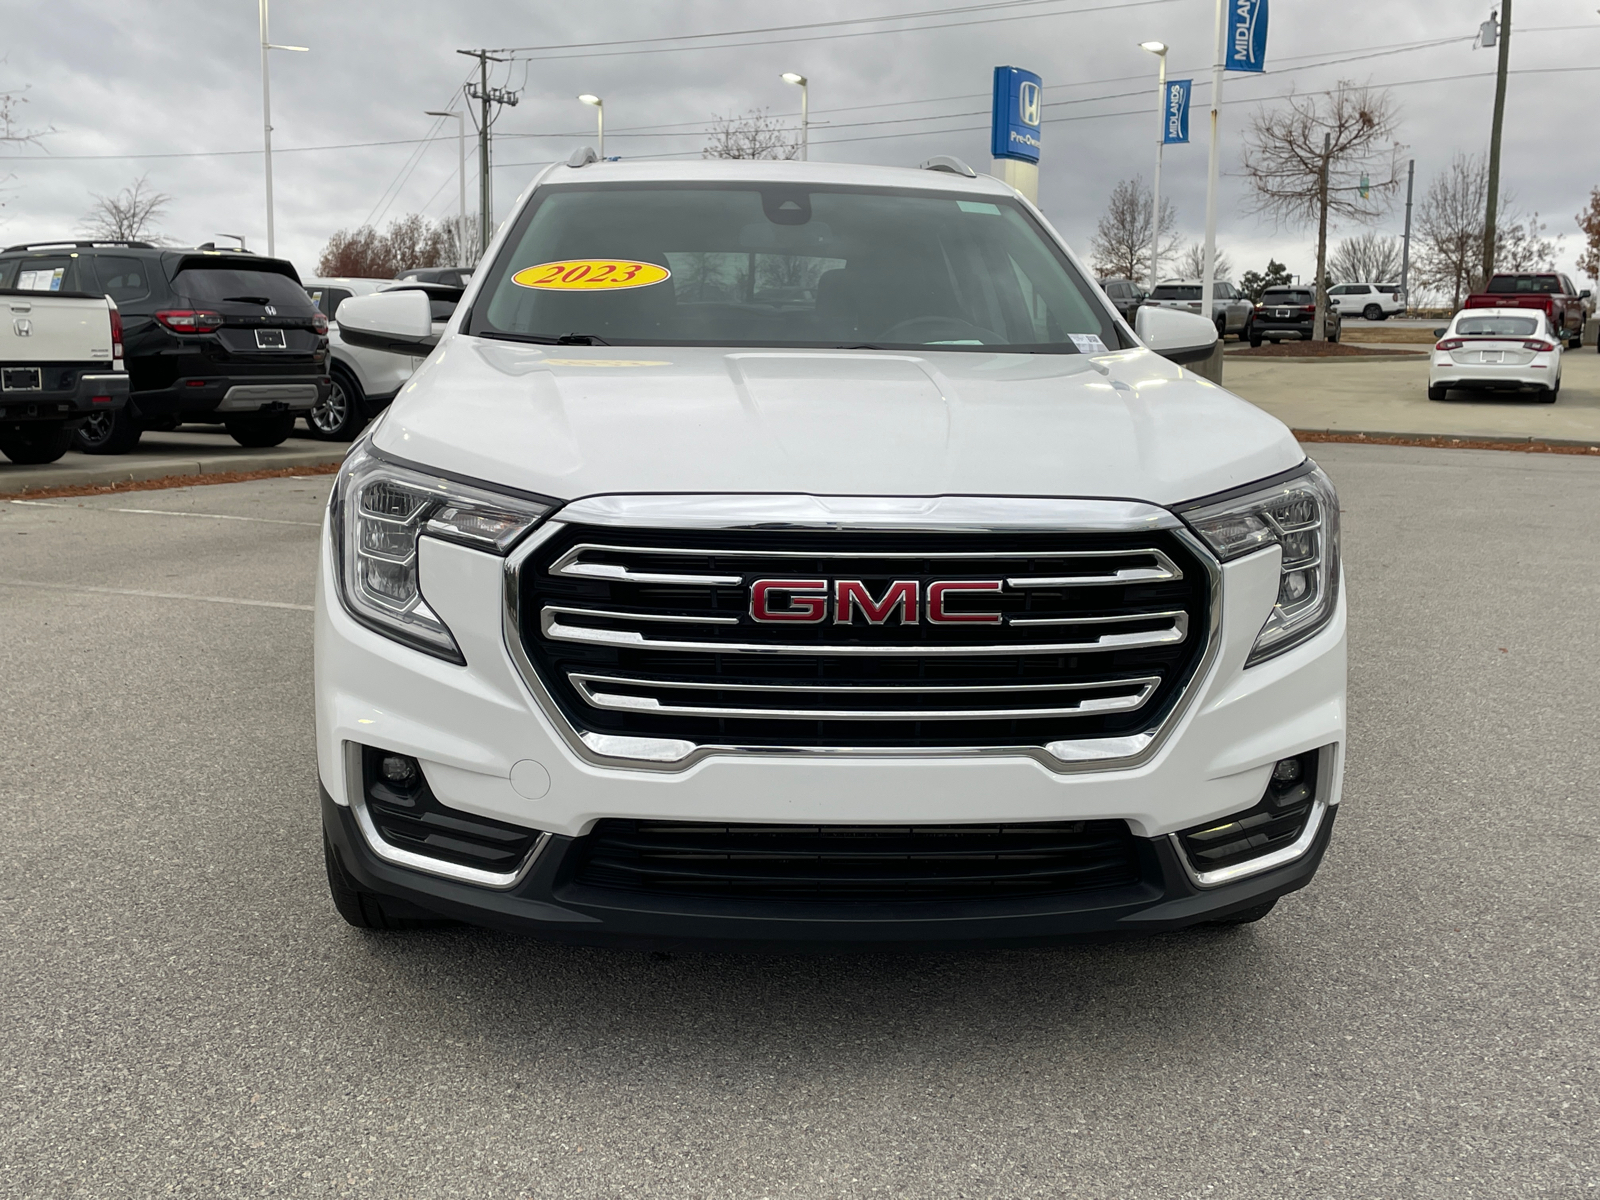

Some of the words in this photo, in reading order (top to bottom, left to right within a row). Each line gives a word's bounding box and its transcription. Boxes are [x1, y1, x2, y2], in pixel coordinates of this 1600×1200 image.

[1168, 84, 1180, 138] MIDLANDS
[1010, 130, 1041, 149] Pre-O
[533, 265, 643, 284] 2023
[748, 579, 1005, 626] GMC
